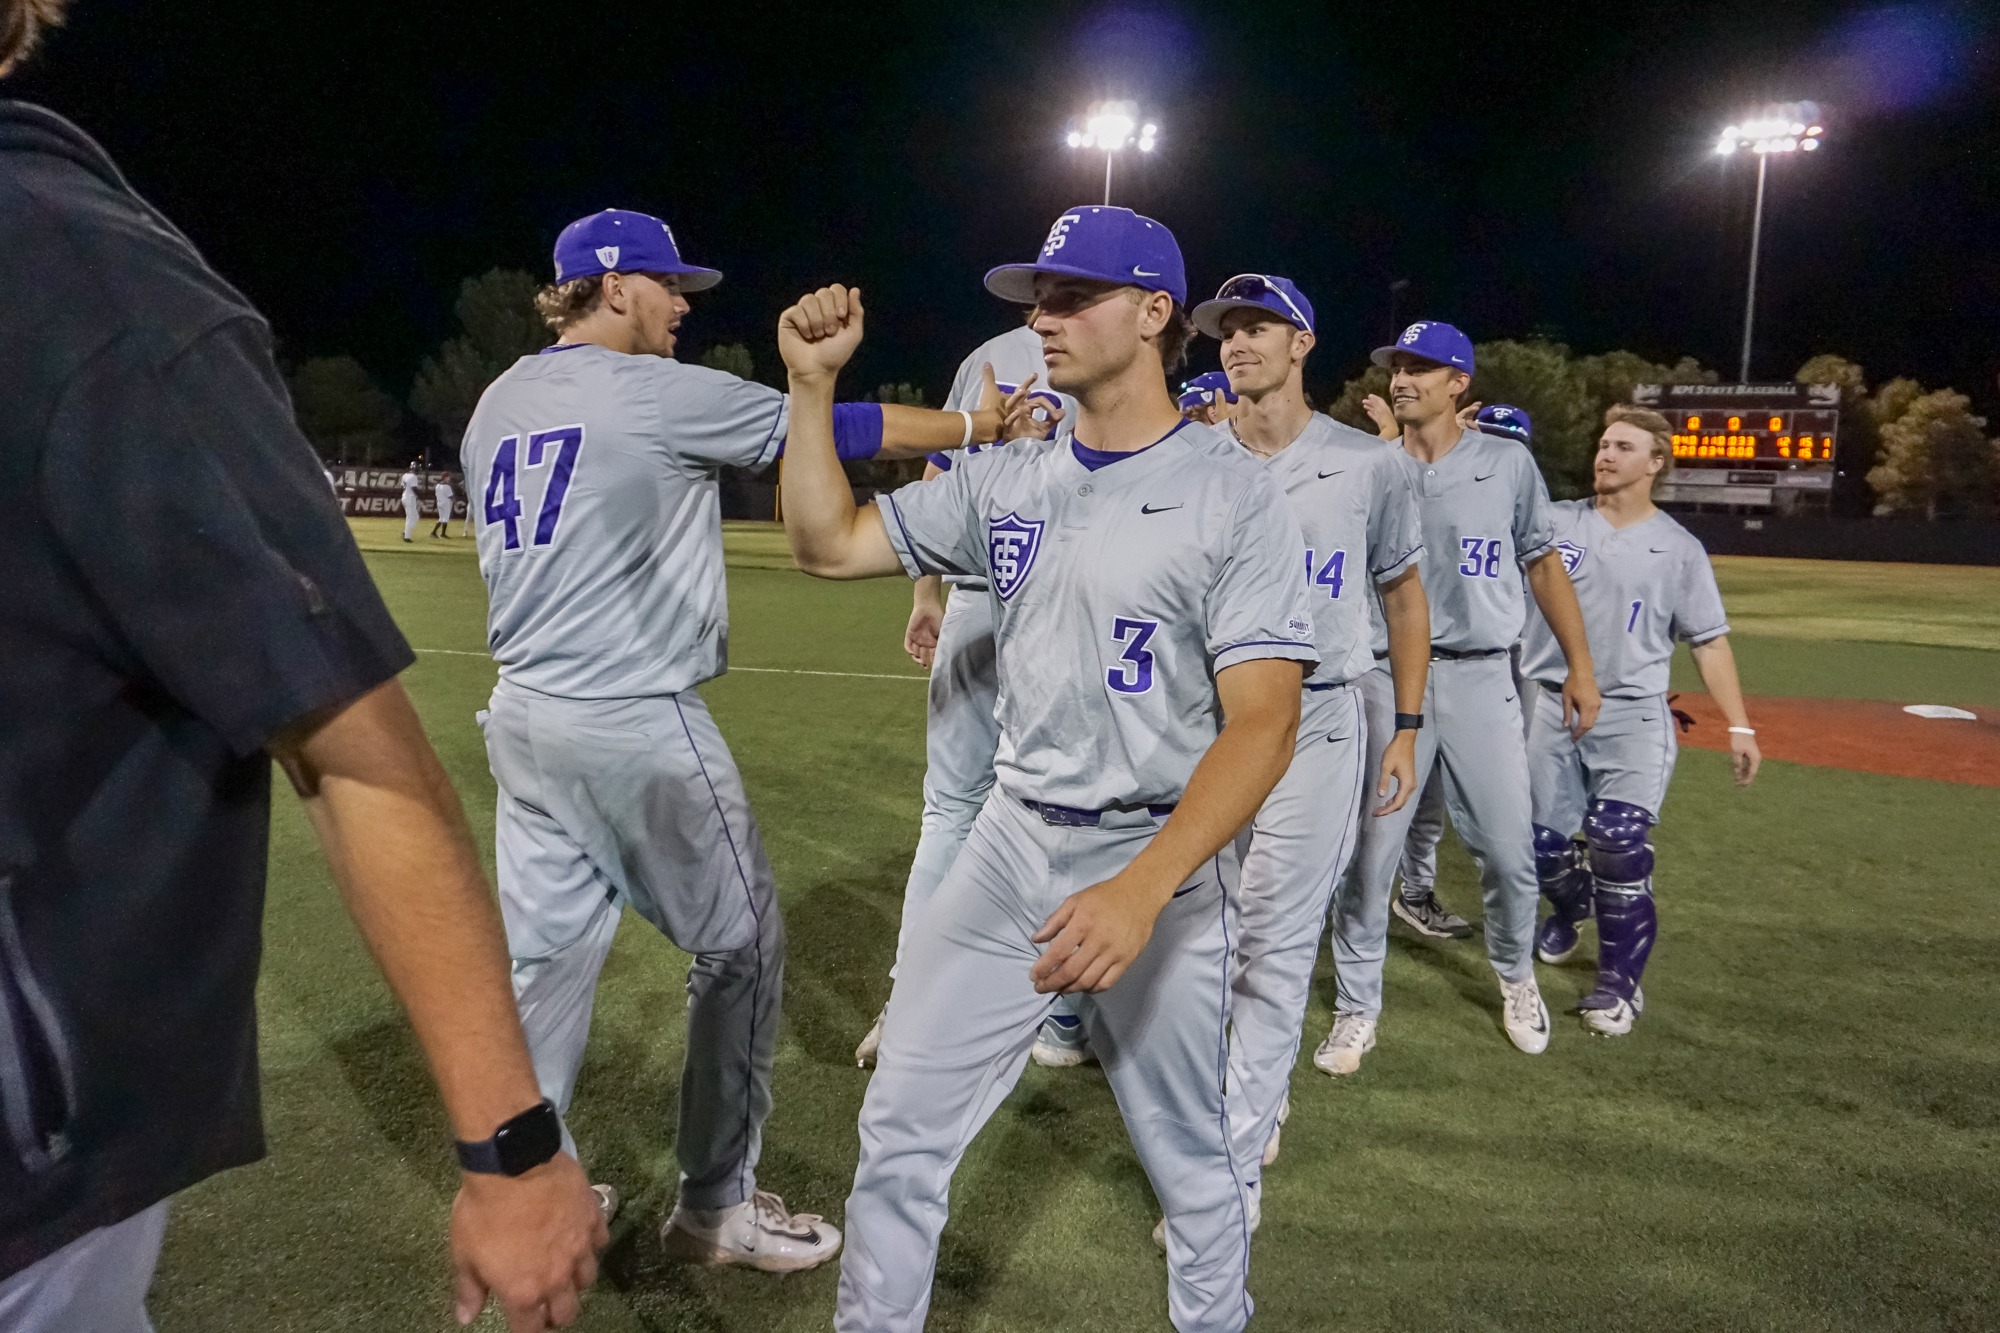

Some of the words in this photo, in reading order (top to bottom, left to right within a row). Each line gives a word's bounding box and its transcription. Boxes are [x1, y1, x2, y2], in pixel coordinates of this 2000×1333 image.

[1735, 385, 1797, 395] BASEBALL
[1769, 416, 1783, 432] 0
[485, 423, 585, 553] 47
[355, 498, 401, 512] NEW
[1459, 536, 1501, 578] 38
[1627, 600, 1643, 633] 1
[1106, 615, 1160, 695] 3
